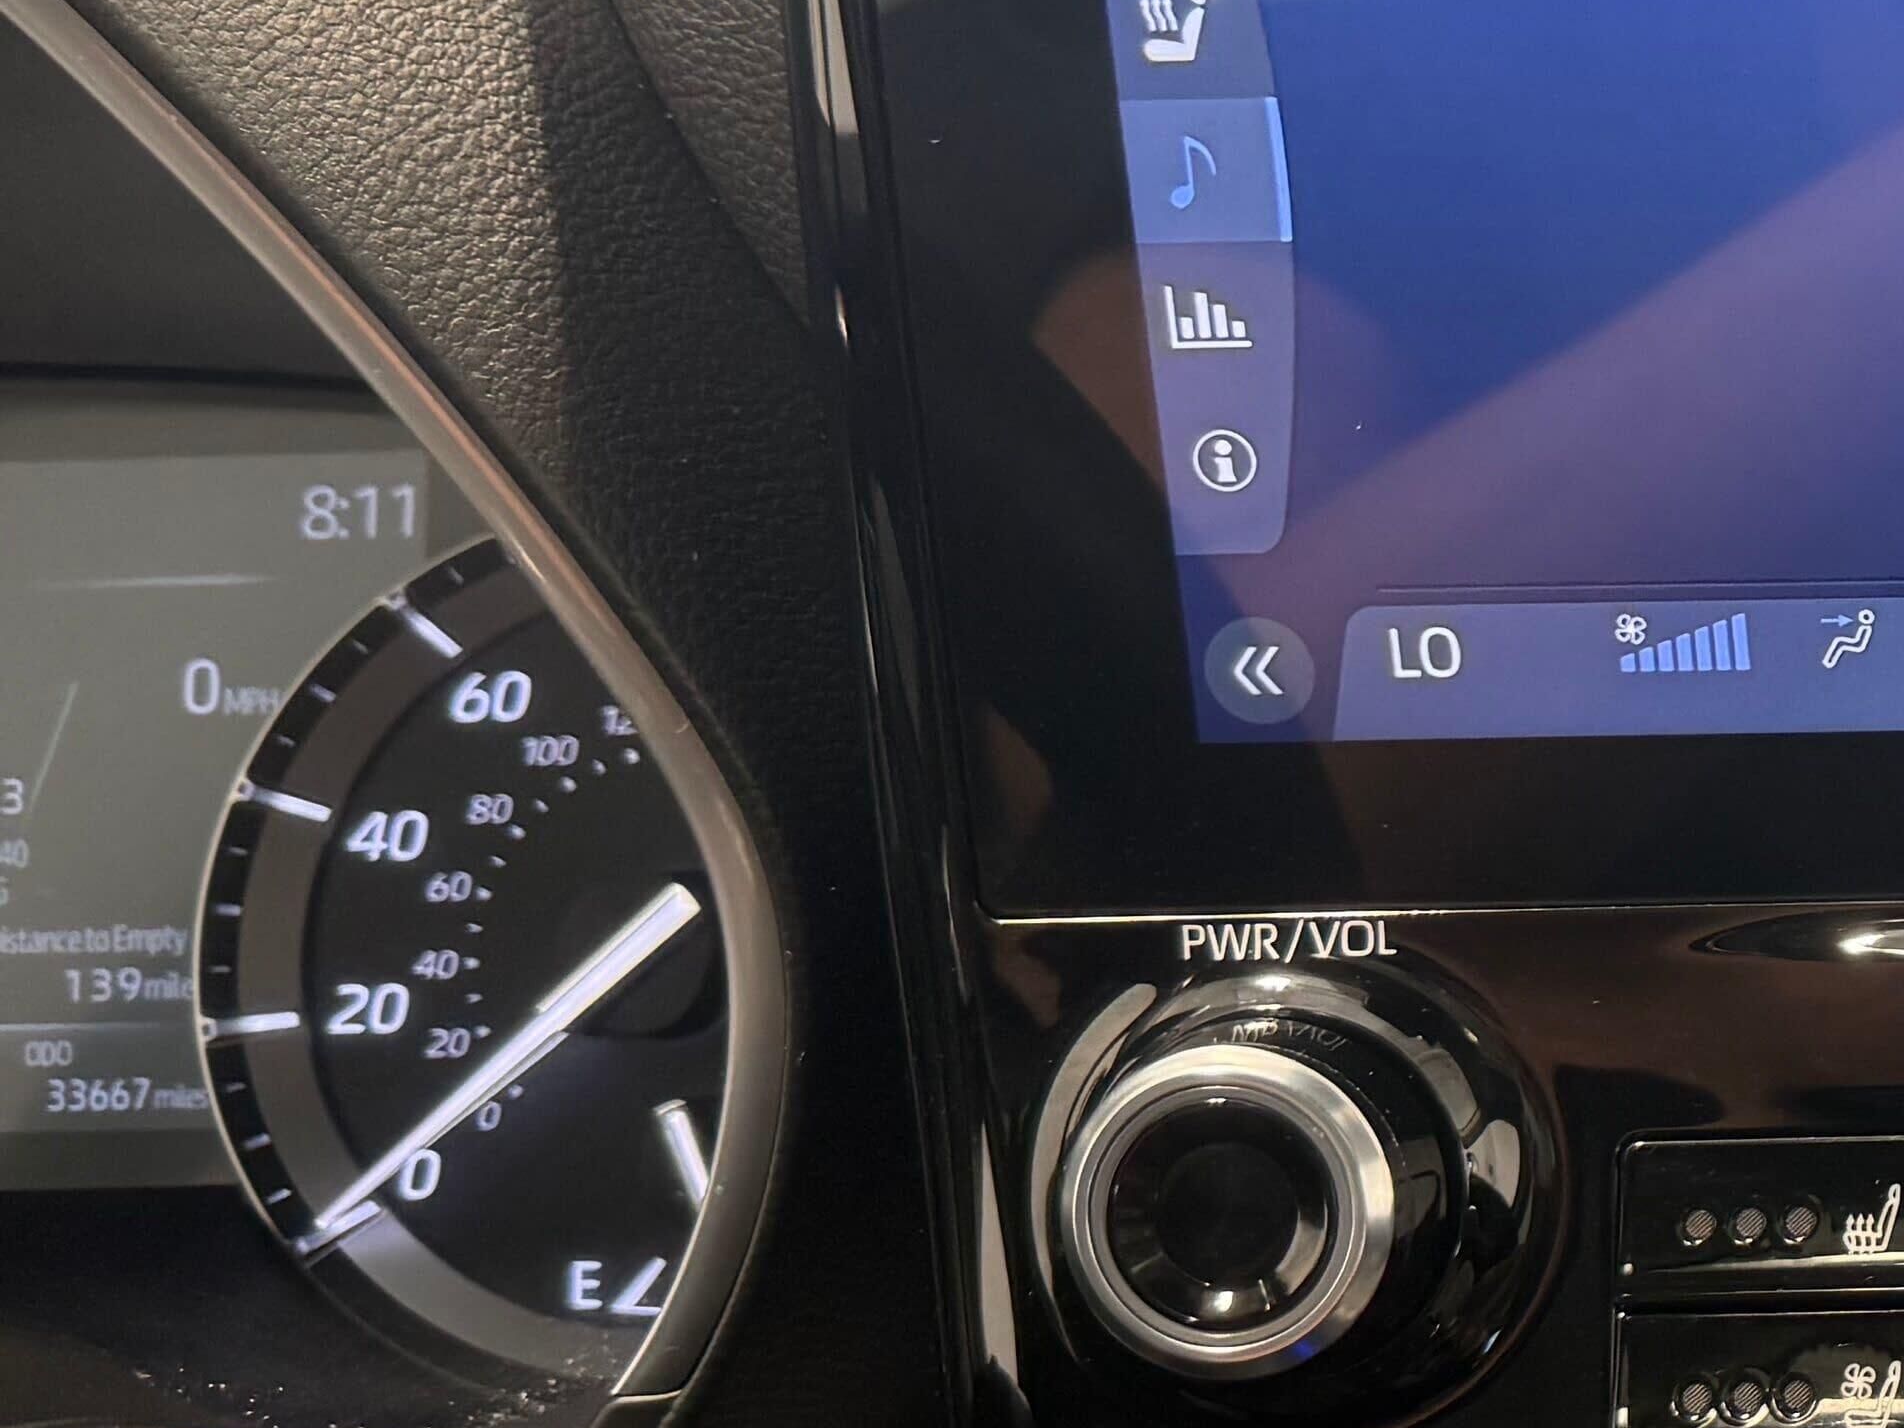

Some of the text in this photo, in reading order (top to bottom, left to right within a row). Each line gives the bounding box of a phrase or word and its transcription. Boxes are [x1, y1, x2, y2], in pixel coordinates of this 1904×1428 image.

[299, 483, 419, 541] 8:11
[1386, 625, 1464, 680] LO
[184, 657, 220, 715] 0
[449, 670, 532, 725] 60
[602, 704, 639, 738] 12
[519, 735, 580, 768] 100
[466, 794, 514, 827] 80
[347, 809, 429, 863] 40
[425, 870, 472, 903] 60
[0, 923, 187, 957] istance to Empty
[1180, 917, 1399, 963] PWR/VOL
[413, 949, 460, 981] 40
[64, 967, 194, 1003] 139 mile
[327, 983, 410, 1036] 20
[25, 1039, 74, 1068] ODO
[424, 1028, 471, 1059] 20
[46, 1076, 152, 1113] 33667
[476, 1100, 503, 1131] 0
[399, 1148, 443, 1202] 0
[564, 1259, 604, 1311] E
